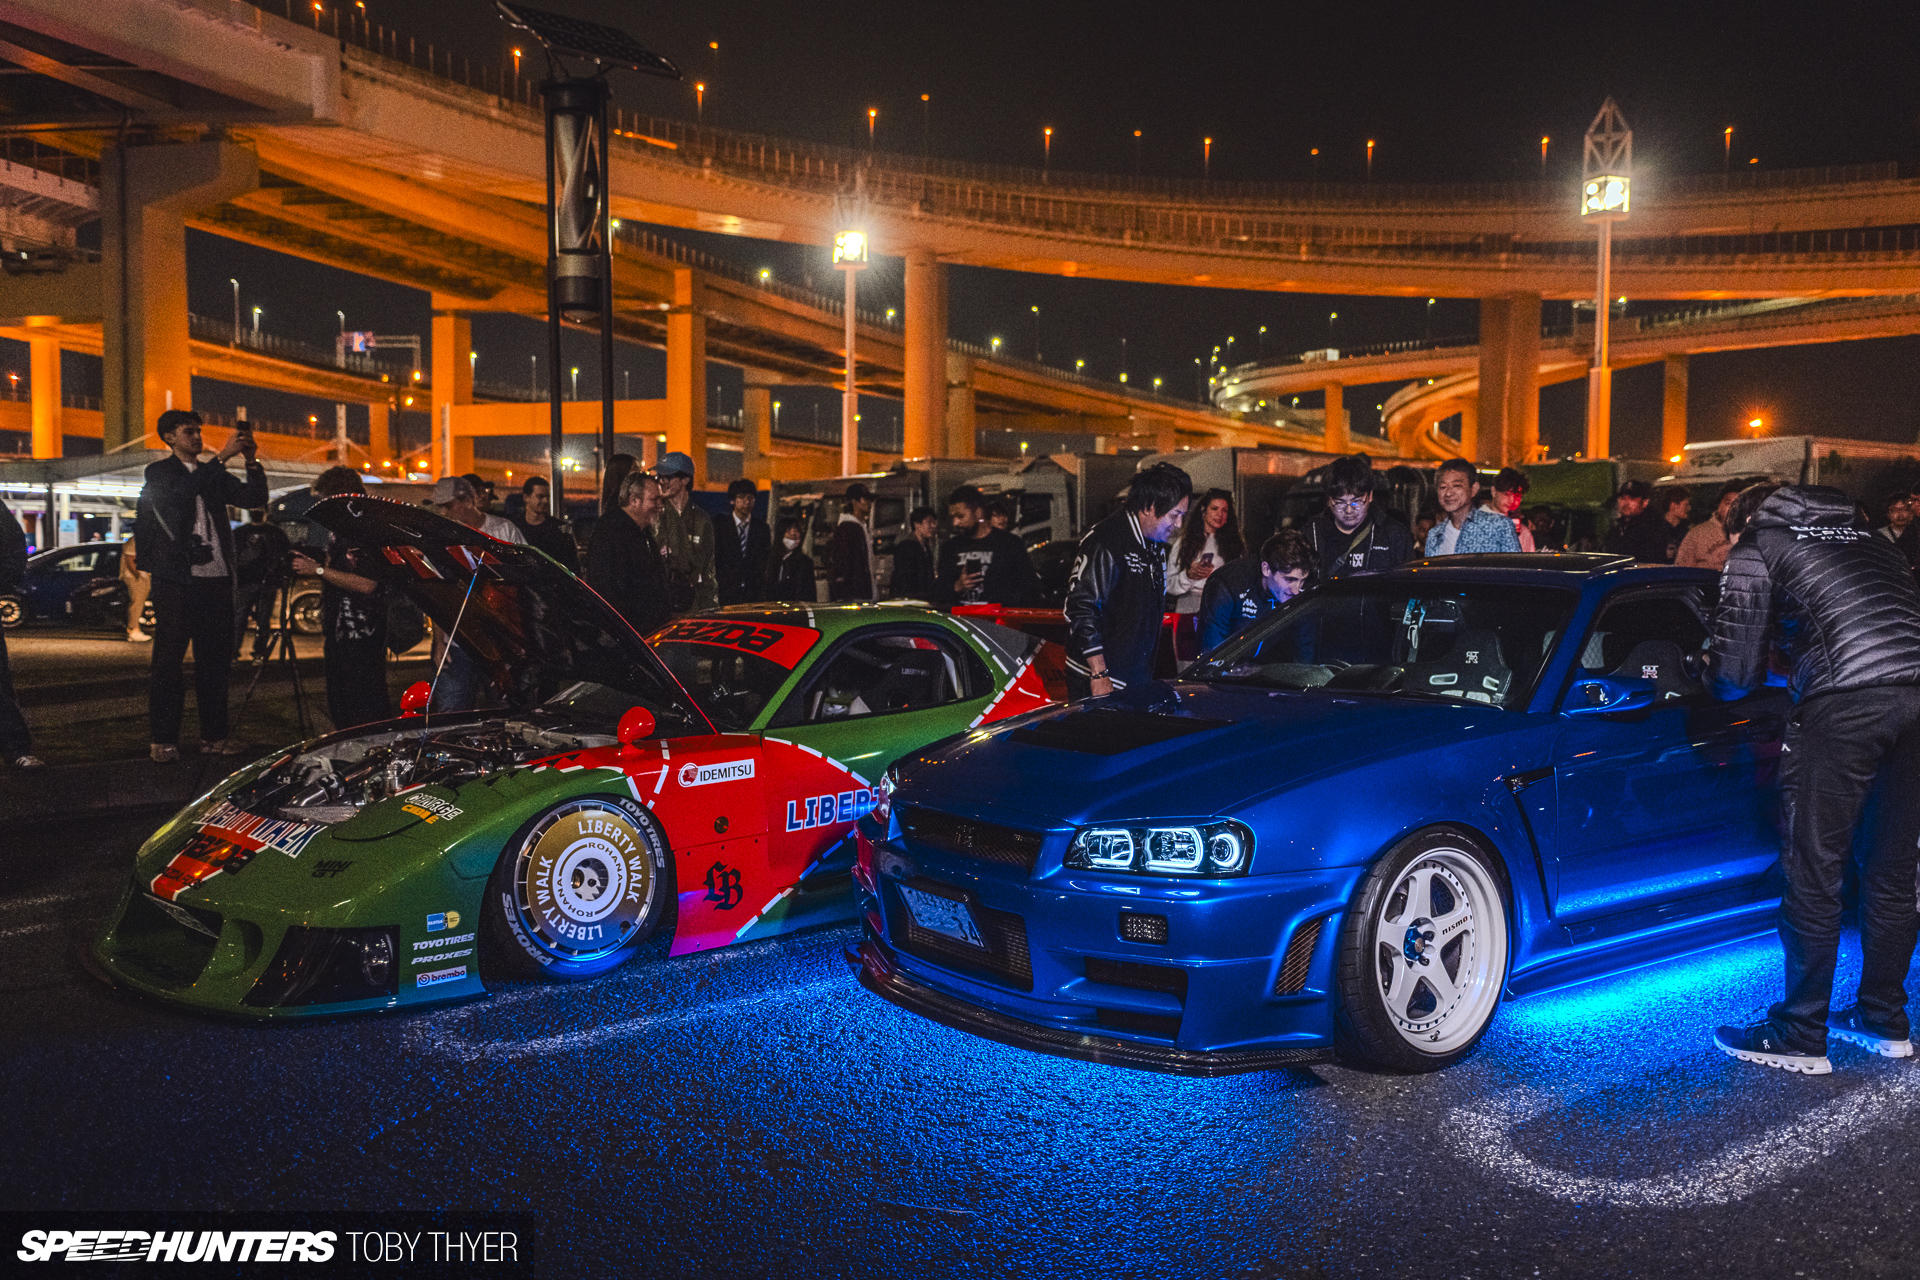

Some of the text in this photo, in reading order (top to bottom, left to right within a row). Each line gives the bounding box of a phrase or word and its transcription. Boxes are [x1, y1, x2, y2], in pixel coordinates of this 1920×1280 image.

[700, 764, 752, 782] IDEMITSU
[405, 793, 464, 820] CHARGE
[619, 797, 666, 869] TOYO TIRES
[578, 819, 642, 903] LIBERTY WALK
[588, 841, 624, 883] ROHANA
[536, 855, 603, 940] LIBERTY WALK
[557, 878, 596, 917] ROHANA
[502, 892, 554, 966] PROXES
[1442, 916, 1468, 935] nismo
[411, 948, 473, 965] PROXES
[431, 969, 465, 981] brembo
